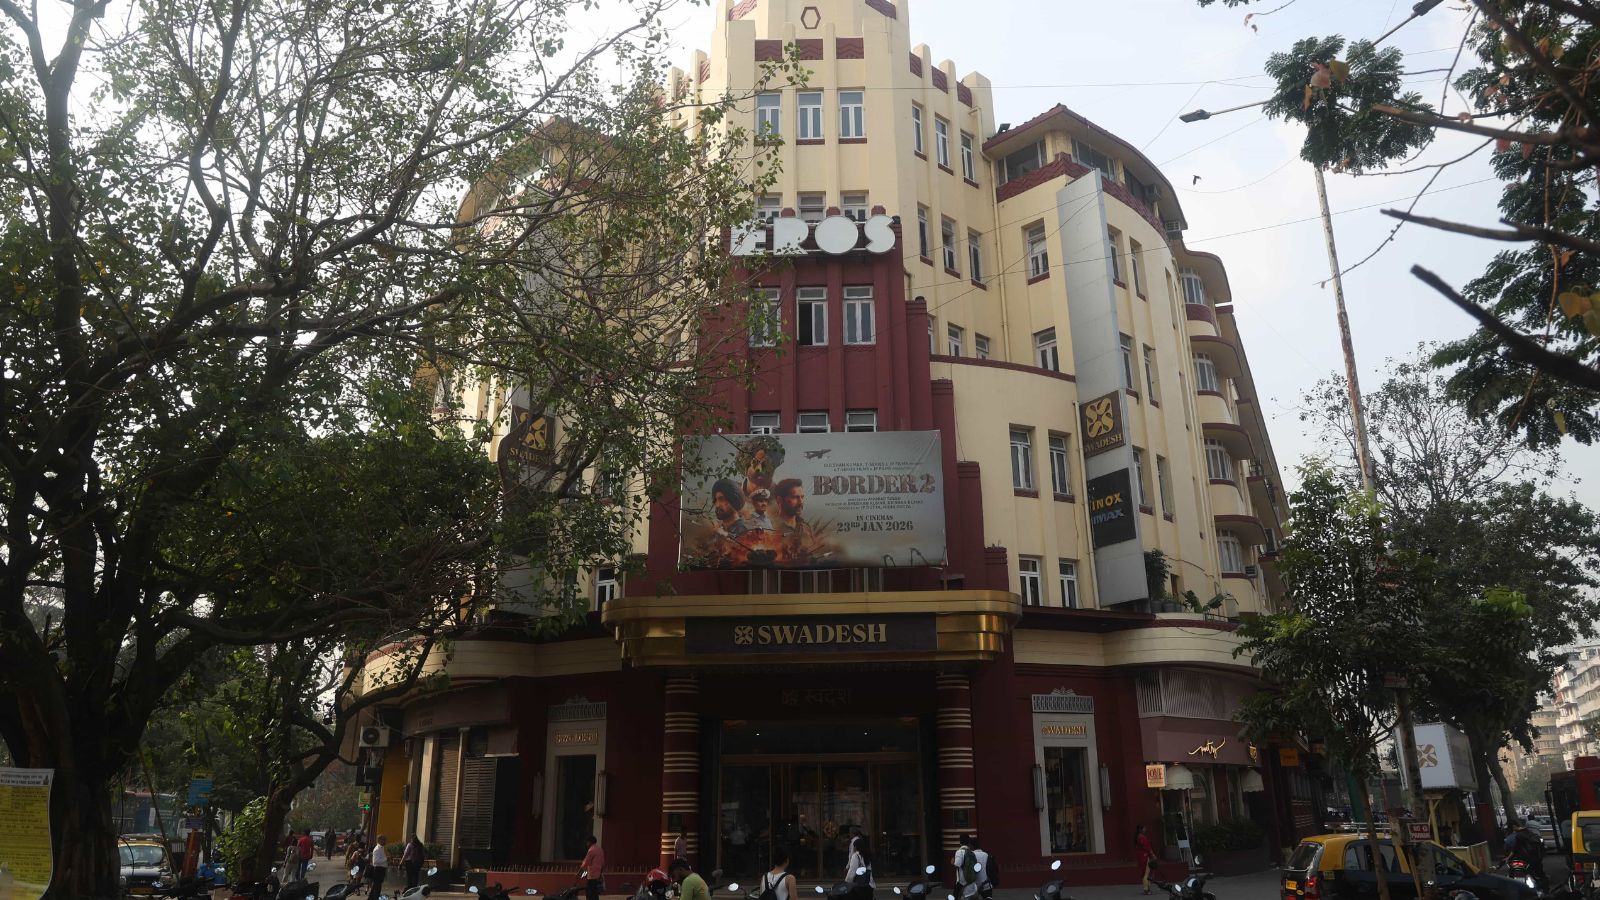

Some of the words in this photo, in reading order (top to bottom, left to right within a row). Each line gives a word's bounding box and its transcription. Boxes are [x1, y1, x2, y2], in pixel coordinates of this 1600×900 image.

[730, 215, 896, 256] EROS
[812, 474, 918, 495] BORDER
[920, 473, 936, 494] 2
[1092, 492, 1121, 511] INOX
[837, 521, 860, 532] 23RD
[861, 521, 883, 532] JAN
[885, 520, 913, 531] 2026
[1093, 509, 1121, 525] IMAX
[757, 623, 887, 644] SWADESH
